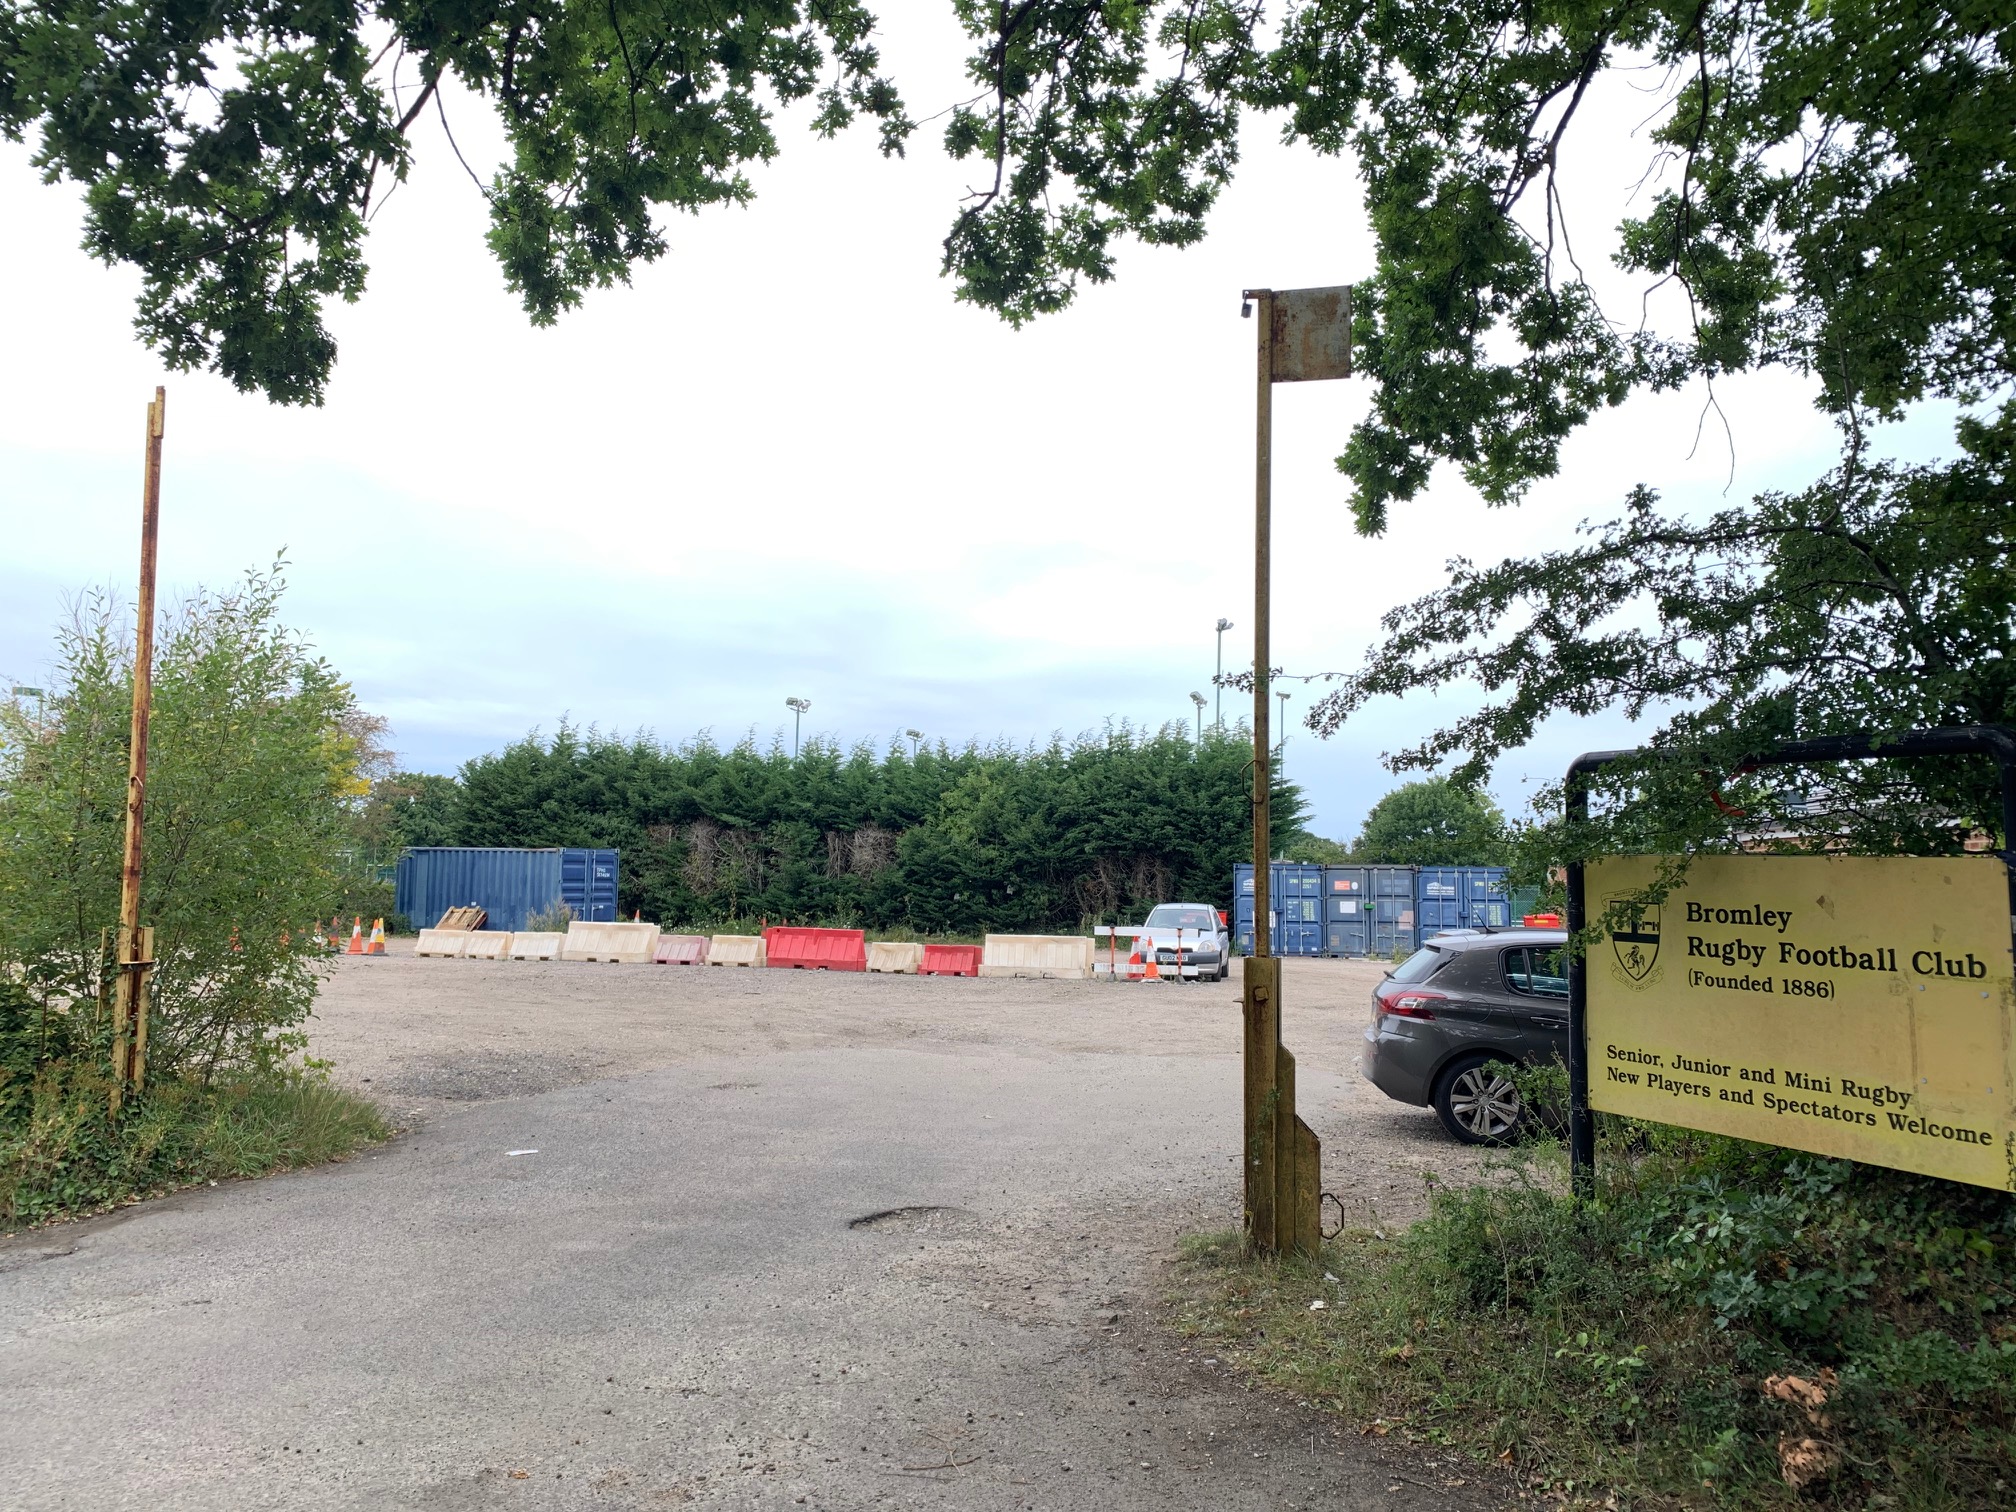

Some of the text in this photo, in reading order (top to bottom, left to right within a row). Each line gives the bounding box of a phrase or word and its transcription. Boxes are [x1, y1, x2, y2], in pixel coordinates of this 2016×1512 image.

[1686, 901, 1793, 933] Bromley
[1687, 936, 1987, 979] Rugby Football Club
[1688, 968, 1835, 1001] (Founded 1886)
[1606, 1045, 1914, 1110] Senior, Junior and Mini Rugby
[1607, 1066, 1993, 1147] New Players and Spectators Welcome
